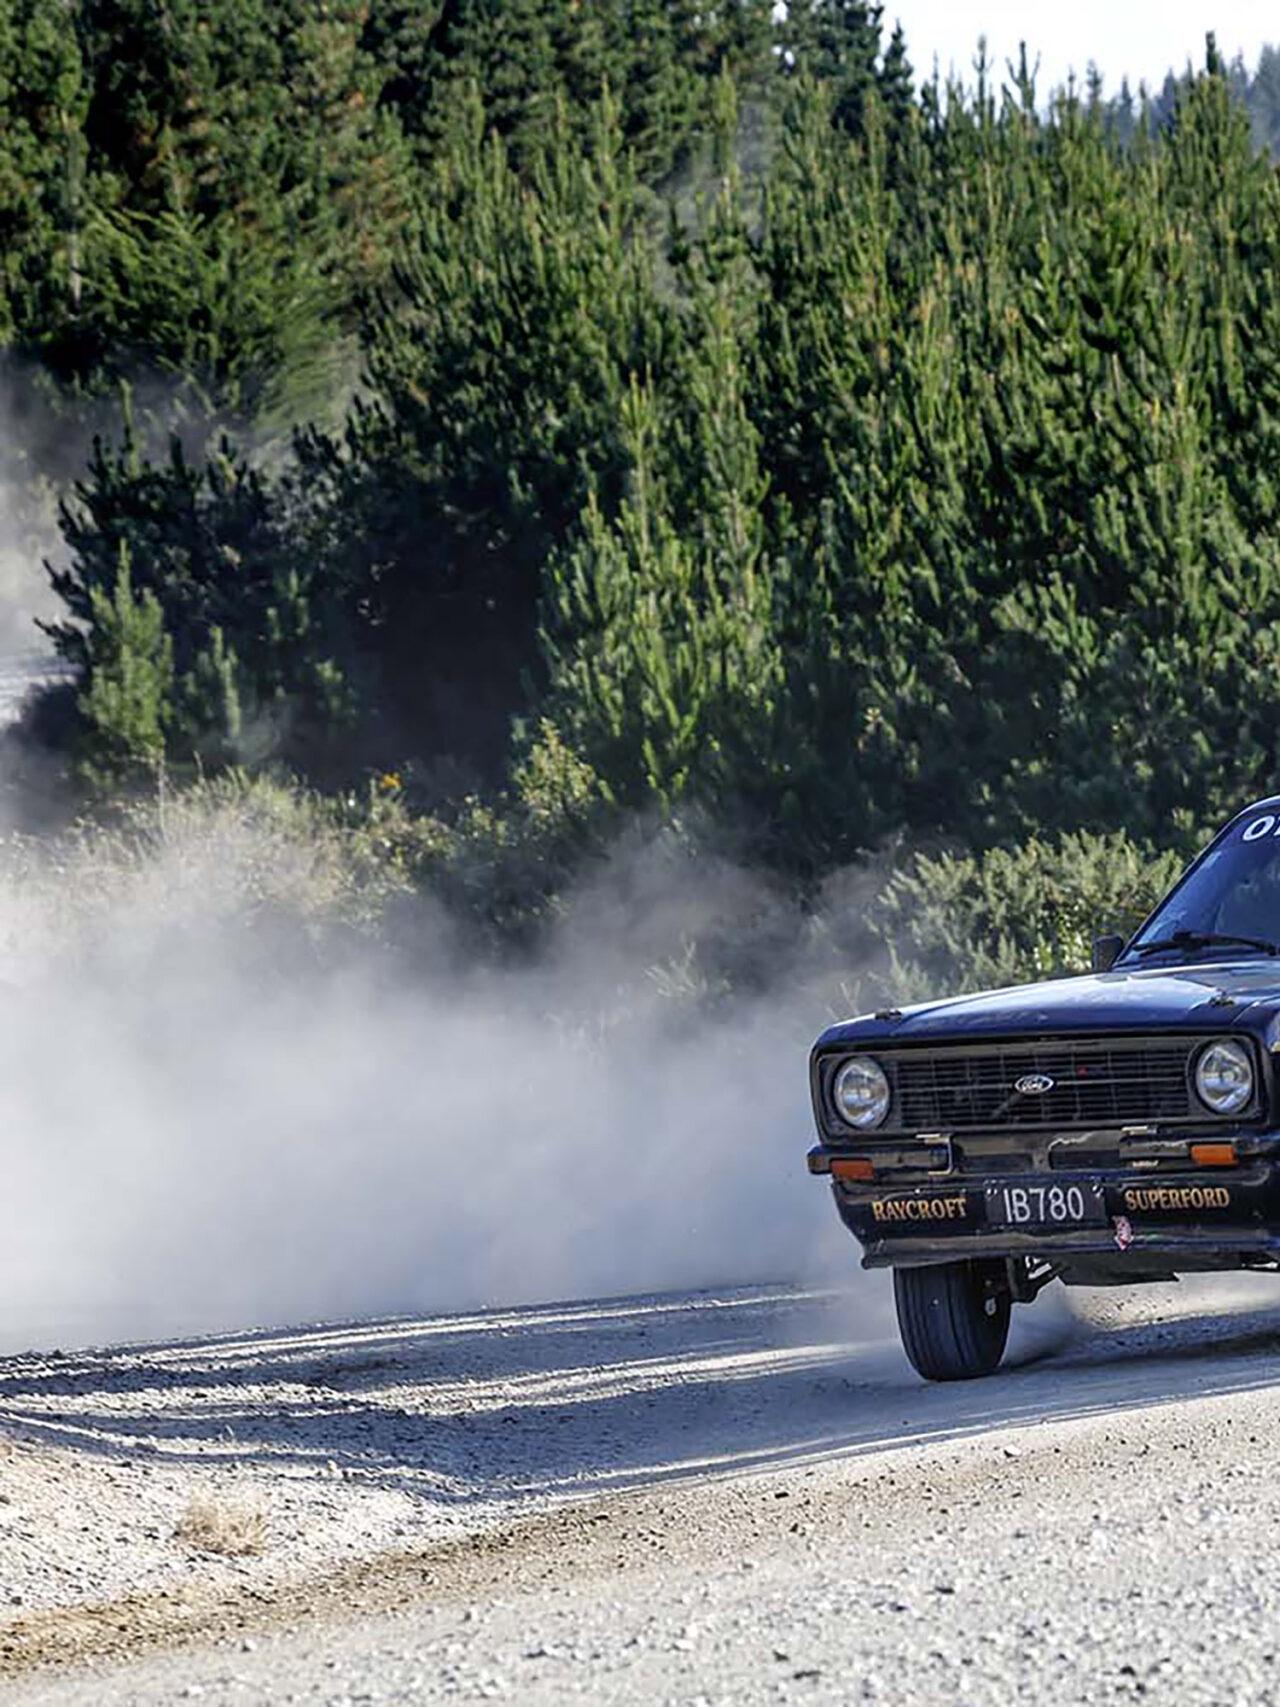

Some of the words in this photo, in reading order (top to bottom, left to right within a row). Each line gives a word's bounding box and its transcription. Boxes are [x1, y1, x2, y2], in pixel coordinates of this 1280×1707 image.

[872, 1197, 966, 1221] RAYCROFT
[1003, 1187, 1084, 1223] IB780
[1125, 1187, 1230, 1210] SUPERFORD
